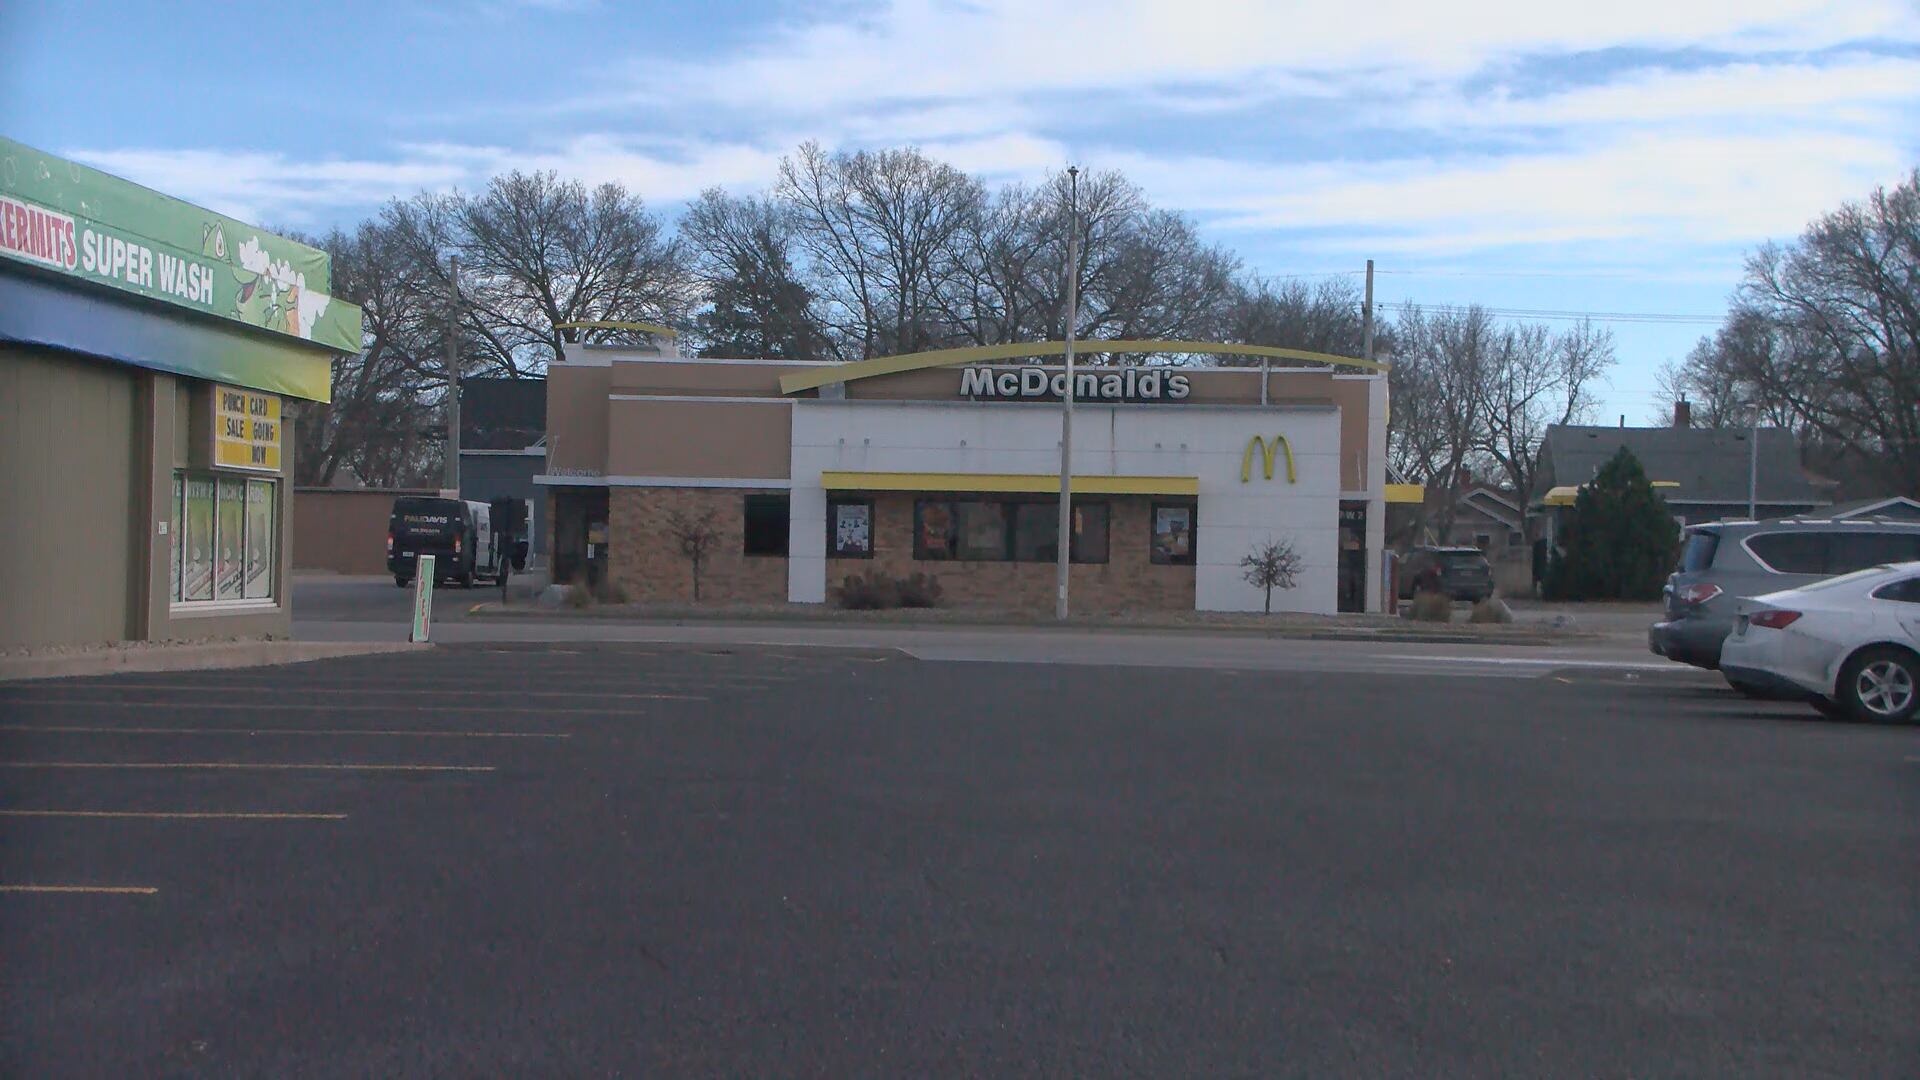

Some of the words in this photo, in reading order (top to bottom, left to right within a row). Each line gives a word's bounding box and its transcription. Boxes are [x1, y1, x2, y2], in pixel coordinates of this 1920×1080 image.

[82, 229, 153, 288] SUPER
[159, 253, 214, 304] WASH
[959, 368, 1190, 399] McDonald's
[223, 393, 245, 414] PUNCH
[250, 398, 268, 416] CARD
[227, 418, 244, 438] SALE
[253, 422, 274, 441] GOING
[252, 445, 266, 464] NOW
